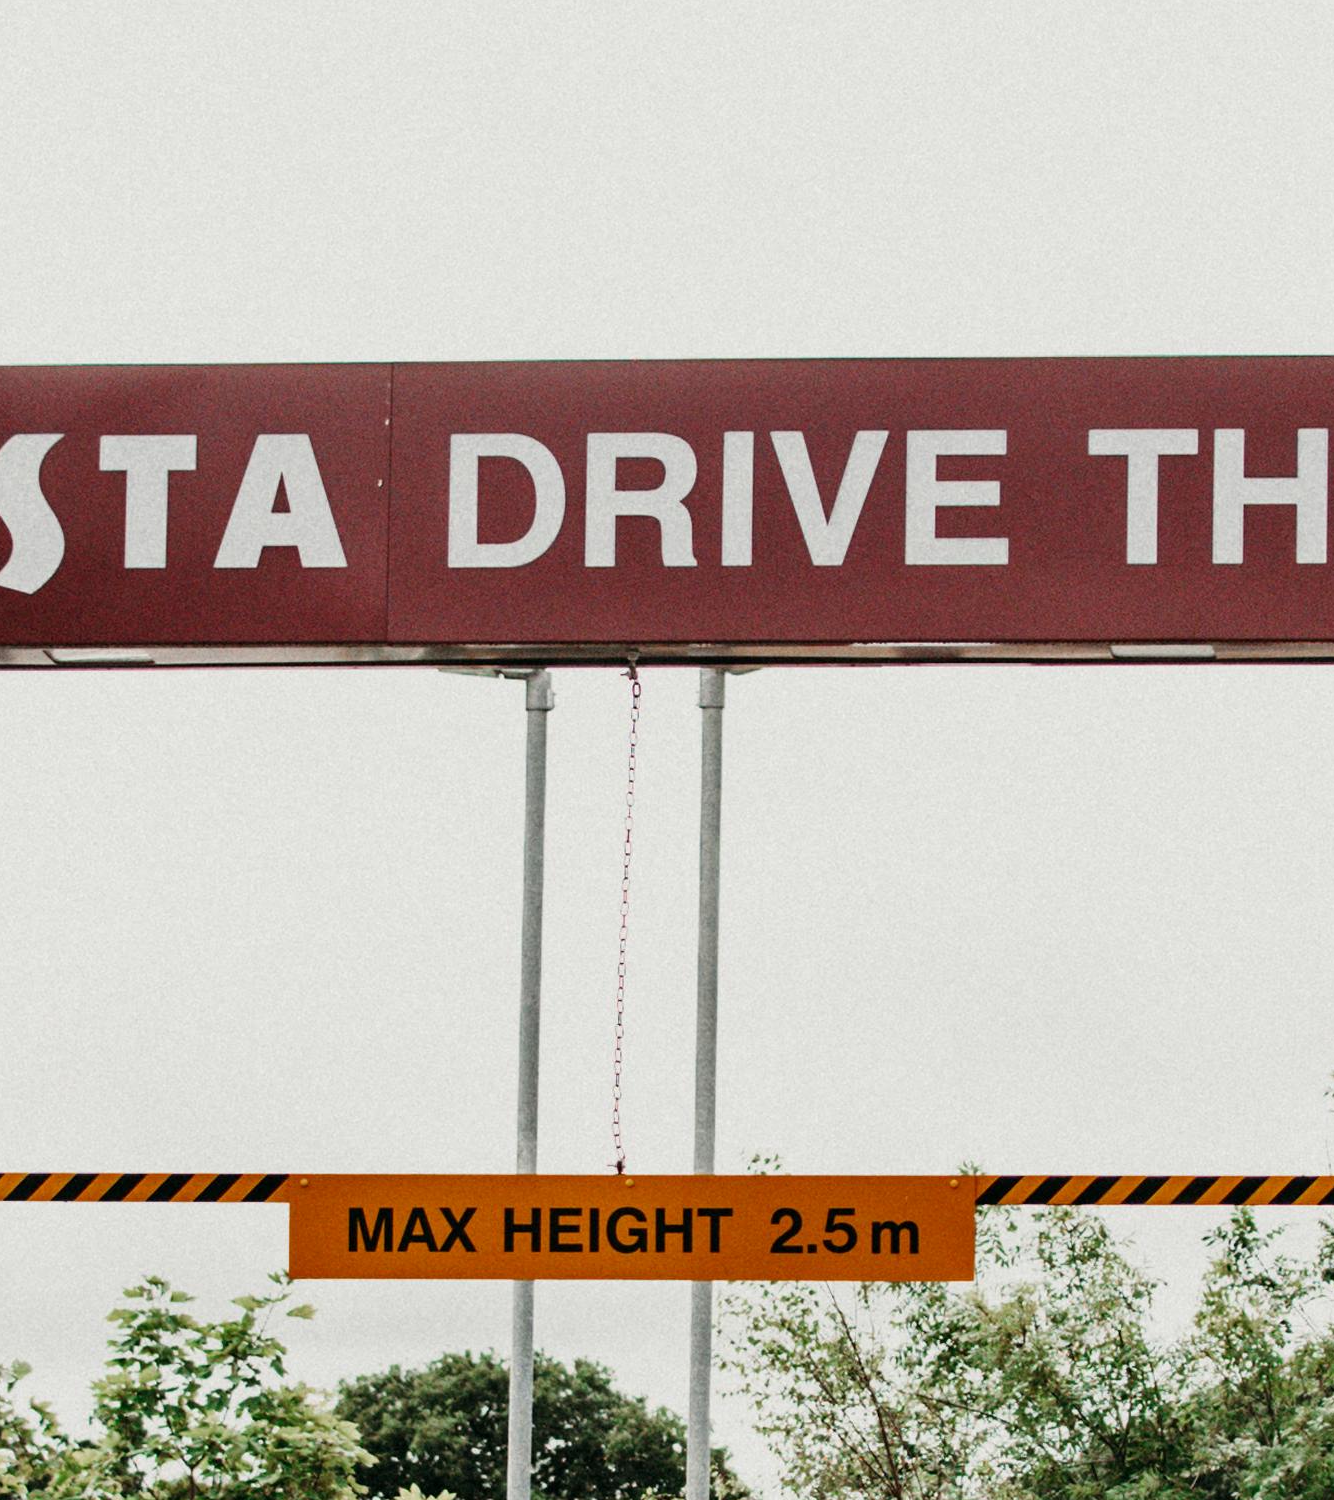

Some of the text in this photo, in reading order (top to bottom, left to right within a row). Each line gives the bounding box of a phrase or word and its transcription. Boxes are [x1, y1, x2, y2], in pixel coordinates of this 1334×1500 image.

[447, 428, 1010, 568] DRIVE
[347, 1206, 477, 1253] MAX
[502, 1206, 734, 1255] HEIGHT
